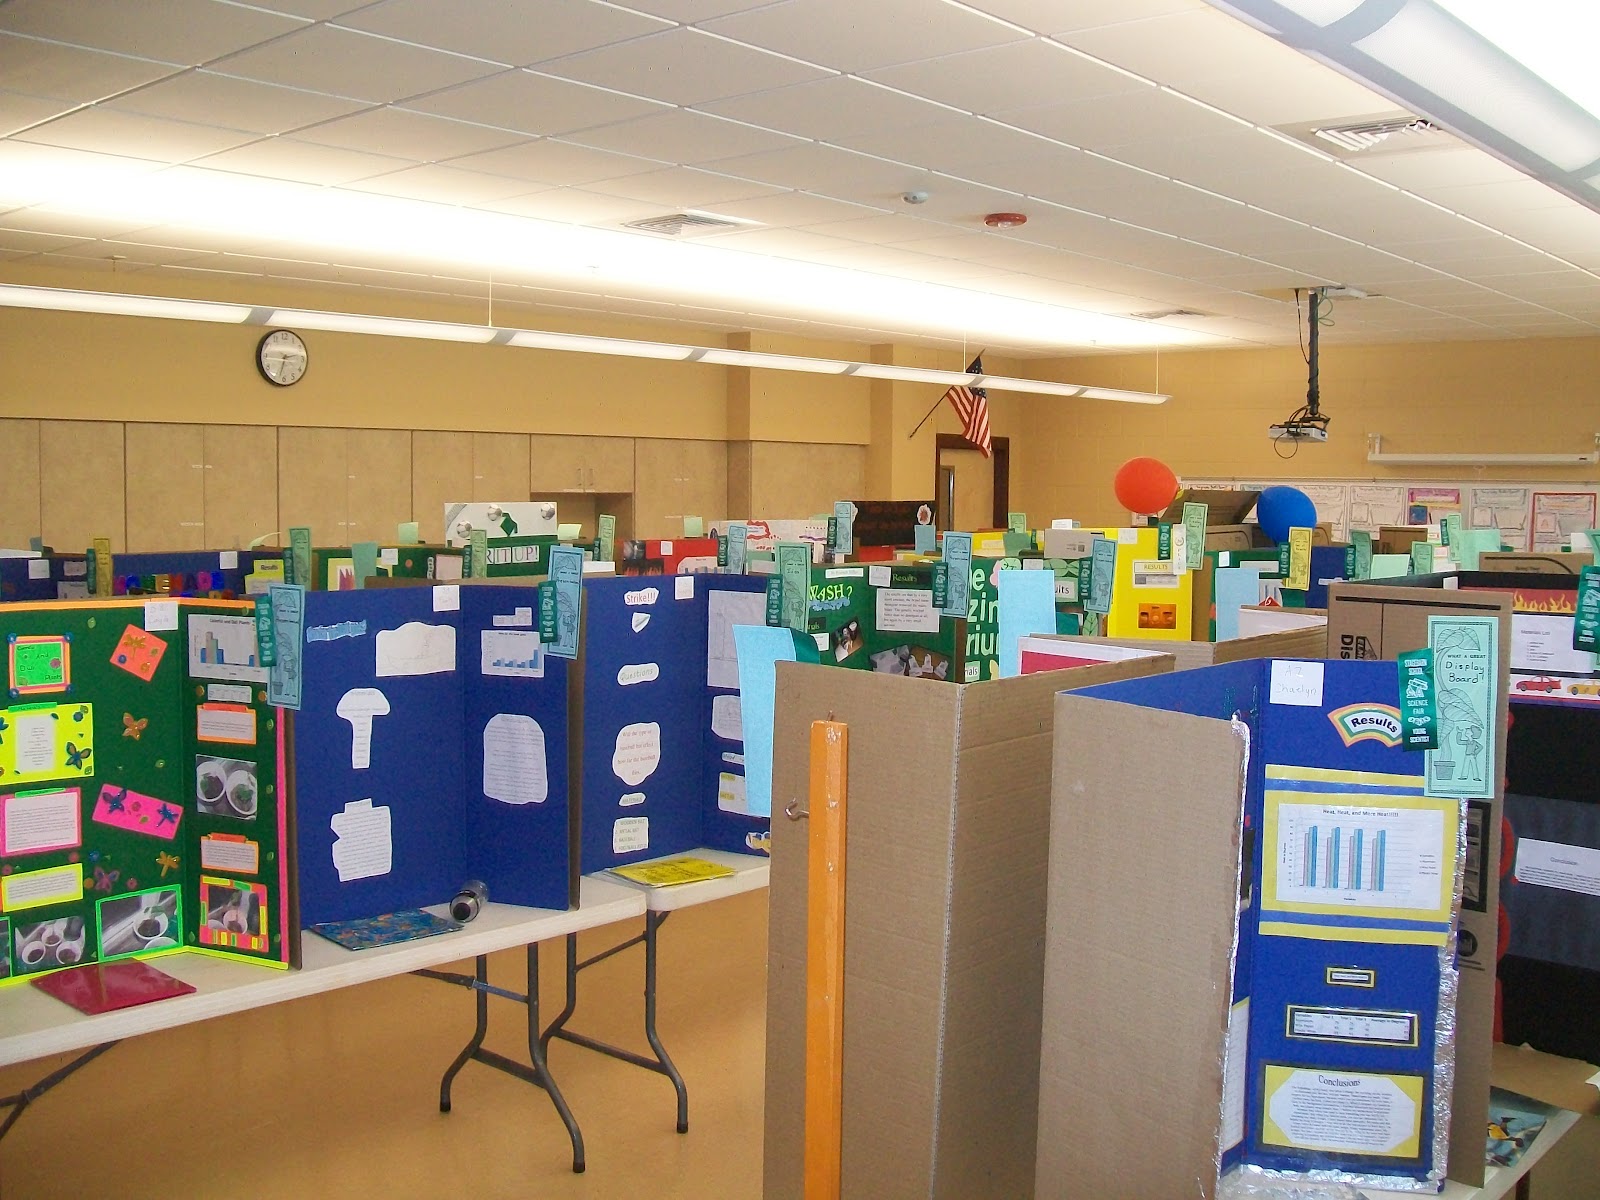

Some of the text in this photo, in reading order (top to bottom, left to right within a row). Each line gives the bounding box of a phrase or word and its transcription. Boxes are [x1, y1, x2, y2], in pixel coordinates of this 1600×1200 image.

[281, 332, 288, 341] 12
[300, 355, 305, 363] 3
[514, 546, 538, 561] UP!
[892, 573, 918, 582] Results
[626, 592, 656, 604] Strike!!!
[966, 624, 999, 656] riu
[1445, 661, 1485, 675] Display
[619, 667, 654, 682] Questions
[1448, 672, 1485, 684] Board!
[1407, 699, 1429, 707] SCIENCE
[1350, 716, 1398, 734] Results
[1317, 1075, 1361, 1087] Conclusions
